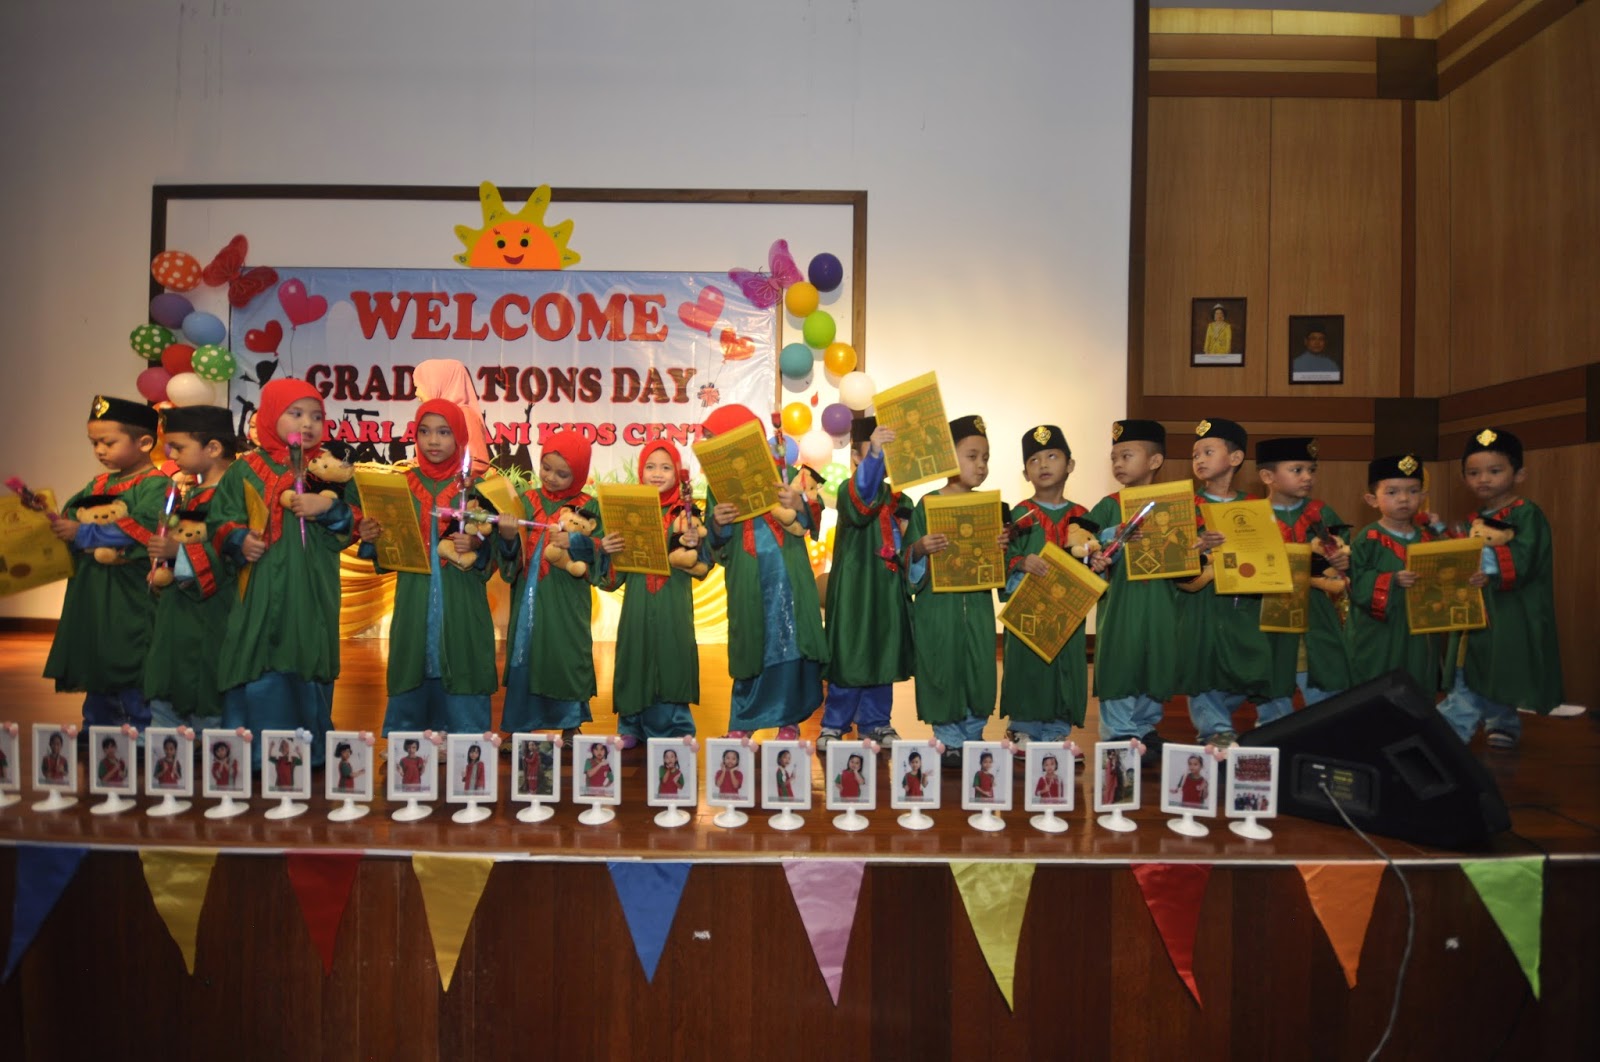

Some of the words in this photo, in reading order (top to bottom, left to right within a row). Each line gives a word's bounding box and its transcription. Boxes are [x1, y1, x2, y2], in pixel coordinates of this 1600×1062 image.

[350, 292, 668, 341] WELCOME
[306, 364, 602, 402] GRADTIONS
[611, 366, 697, 404] DAY
[623, 423, 704, 446] CENT
